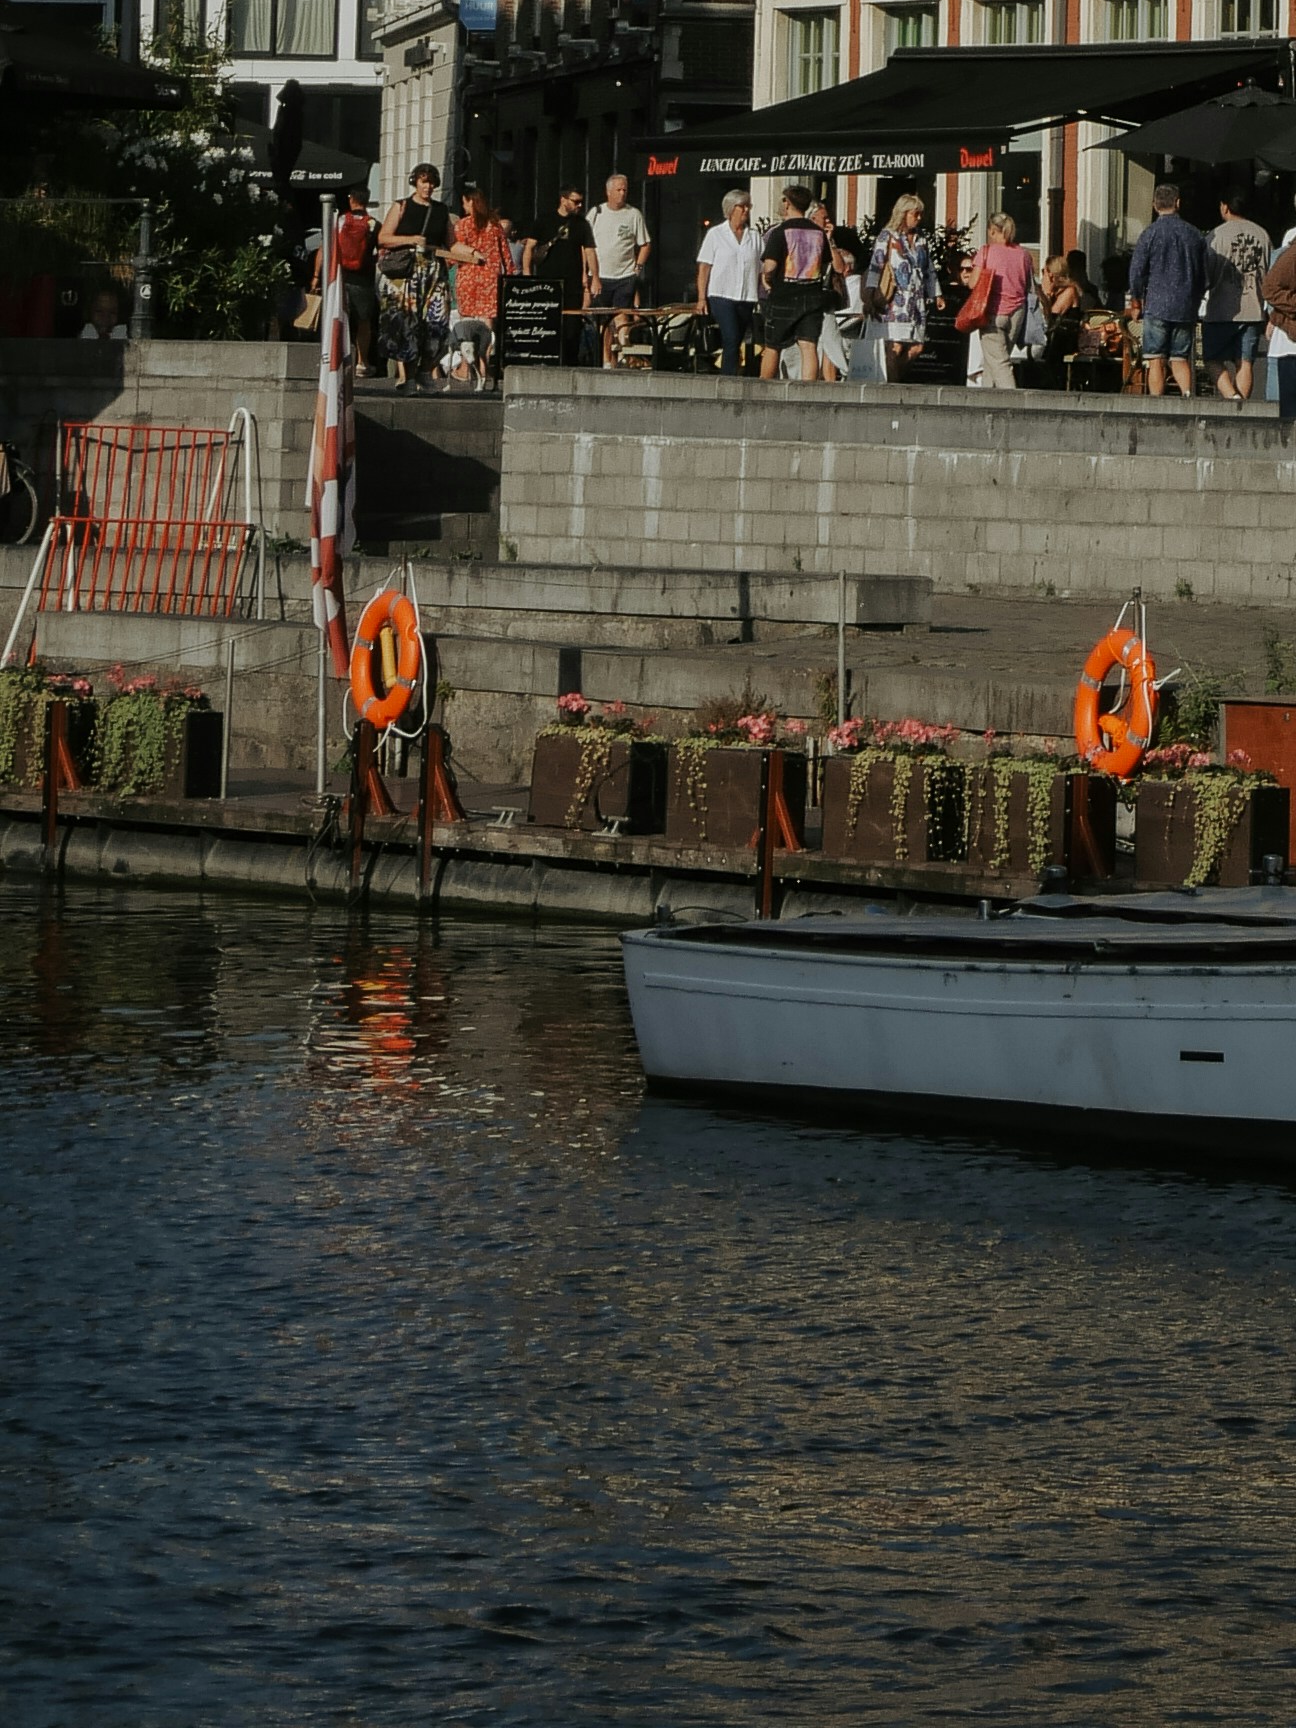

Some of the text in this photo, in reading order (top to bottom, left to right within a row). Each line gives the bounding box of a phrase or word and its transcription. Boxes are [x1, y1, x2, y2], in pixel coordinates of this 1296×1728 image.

[465, 1, 494, 11] HUUR
[647, 154, 680, 176] Duvel
[700, 158, 735, 172] LUNCH
[734, 157, 762, 172] CAFE
[770, 154, 787, 173] DE
[787, 154, 836, 173] ZWARTE
[838, 153, 863, 173] ZEE
[872, 153, 925, 169] TEA-ROOM
[959, 146, 994, 169] Duvel
[308, 171, 322, 180] ice
[323, 171, 343, 180] cold
